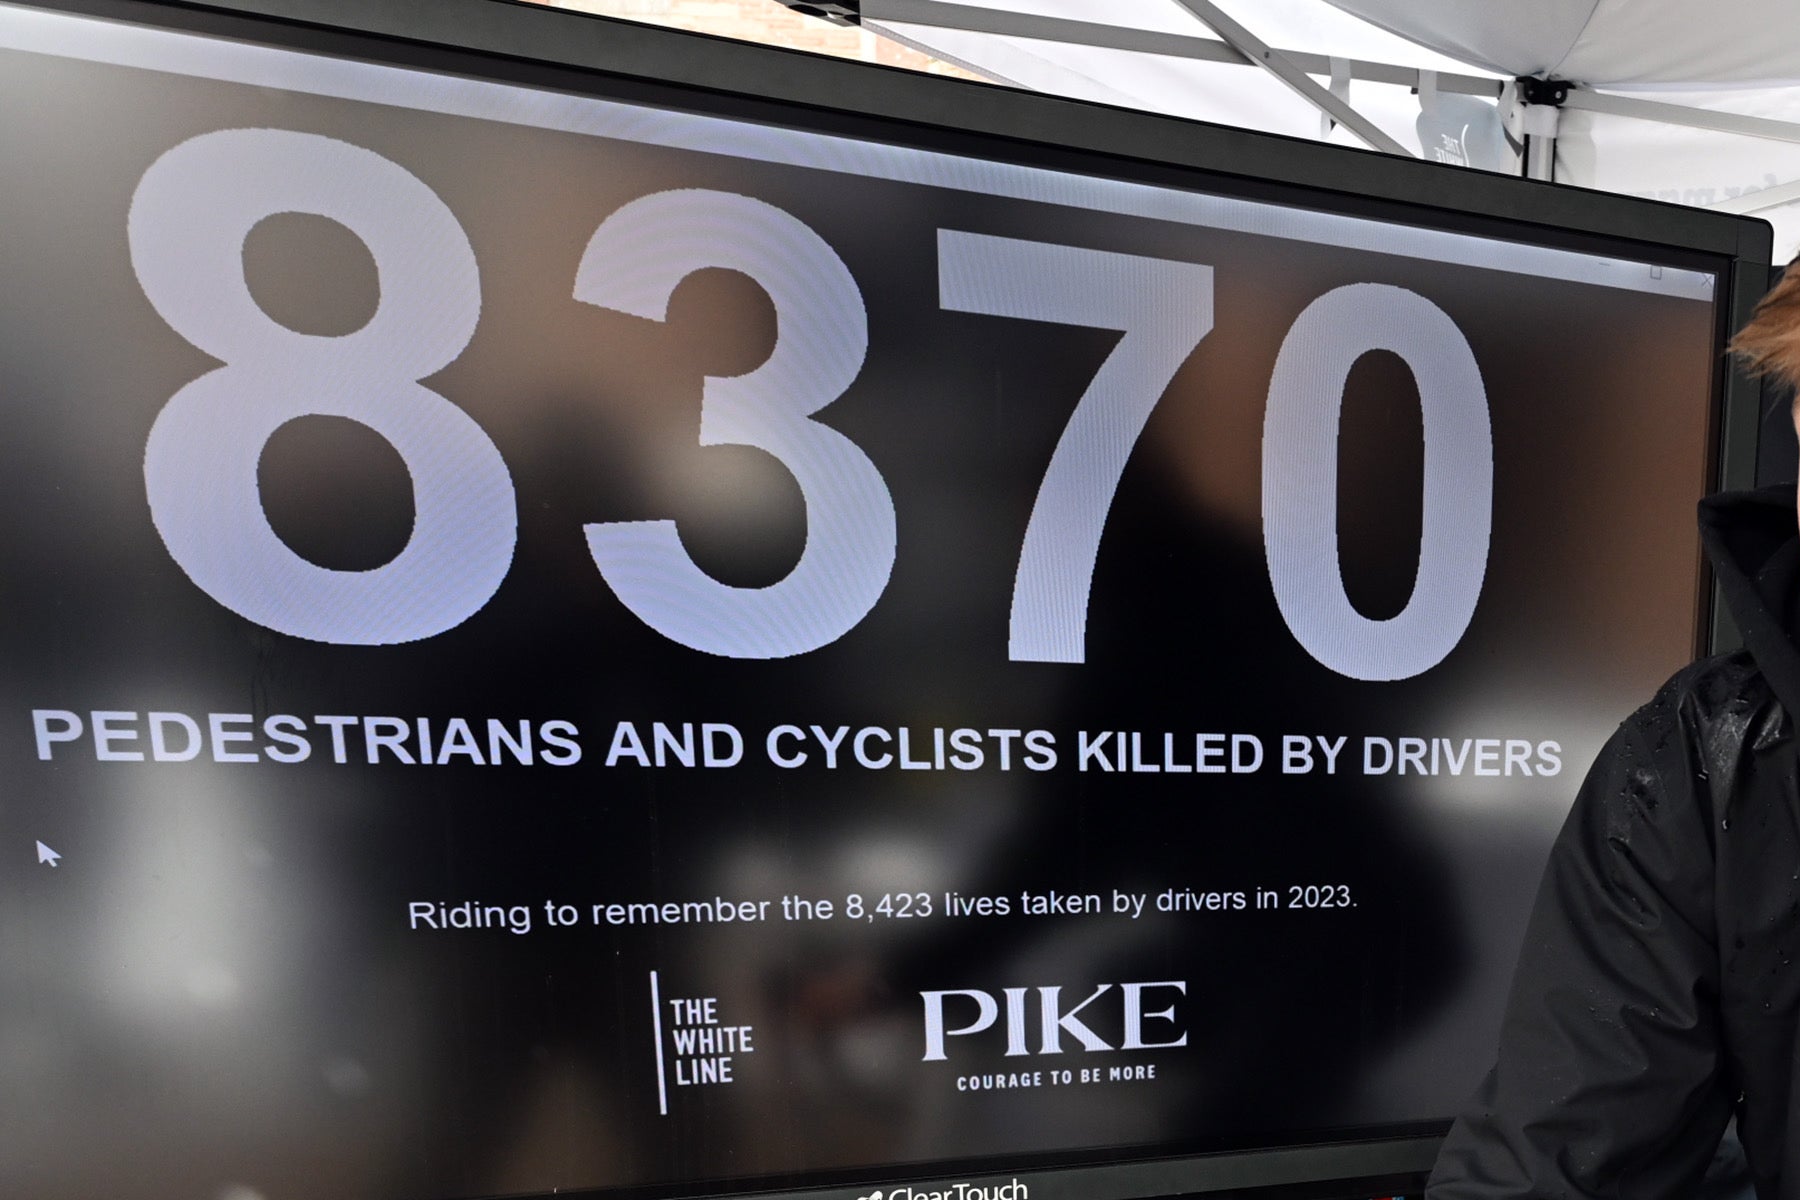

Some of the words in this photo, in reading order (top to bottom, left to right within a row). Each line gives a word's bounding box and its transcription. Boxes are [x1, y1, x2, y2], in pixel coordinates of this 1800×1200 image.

[127, 127, 1494, 682] 8370
[33, 710, 582, 766] PEDESTRIANS
[605, 721, 744, 768] AND
[767, 725, 1058, 772] CYCLISTS
[1078, 731, 1264, 774] KILLED
[1282, 735, 1348, 775] BY
[1363, 737, 1563, 777] DRIVERS
[409, 901, 531, 935] Riding
[544, 899, 579, 926] to
[592, 896, 771, 925] remember
[782, 895, 834, 920] the
[846, 893, 933, 923] 8,423
[945, 892, 1011, 917] lives
[1021, 890, 1101, 915] taken
[1112, 889, 1147, 919] by
[1156, 888, 1247, 912] drivers
[1256, 886, 1278, 910] in
[1288, 884, 1359, 909] 2023.
[669, 997, 719, 1026] THE
[919, 980, 1188, 1062] PIKE
[672, 1025, 754, 1056] WHITE
[675, 1056, 734, 1086] LINE
[956, 1071, 1042, 1092] COURAGE
[1050, 1069, 1072, 1085] TO
[1080, 1067, 1101, 1084] BE
[1109, 1064, 1156, 1082] MORE
